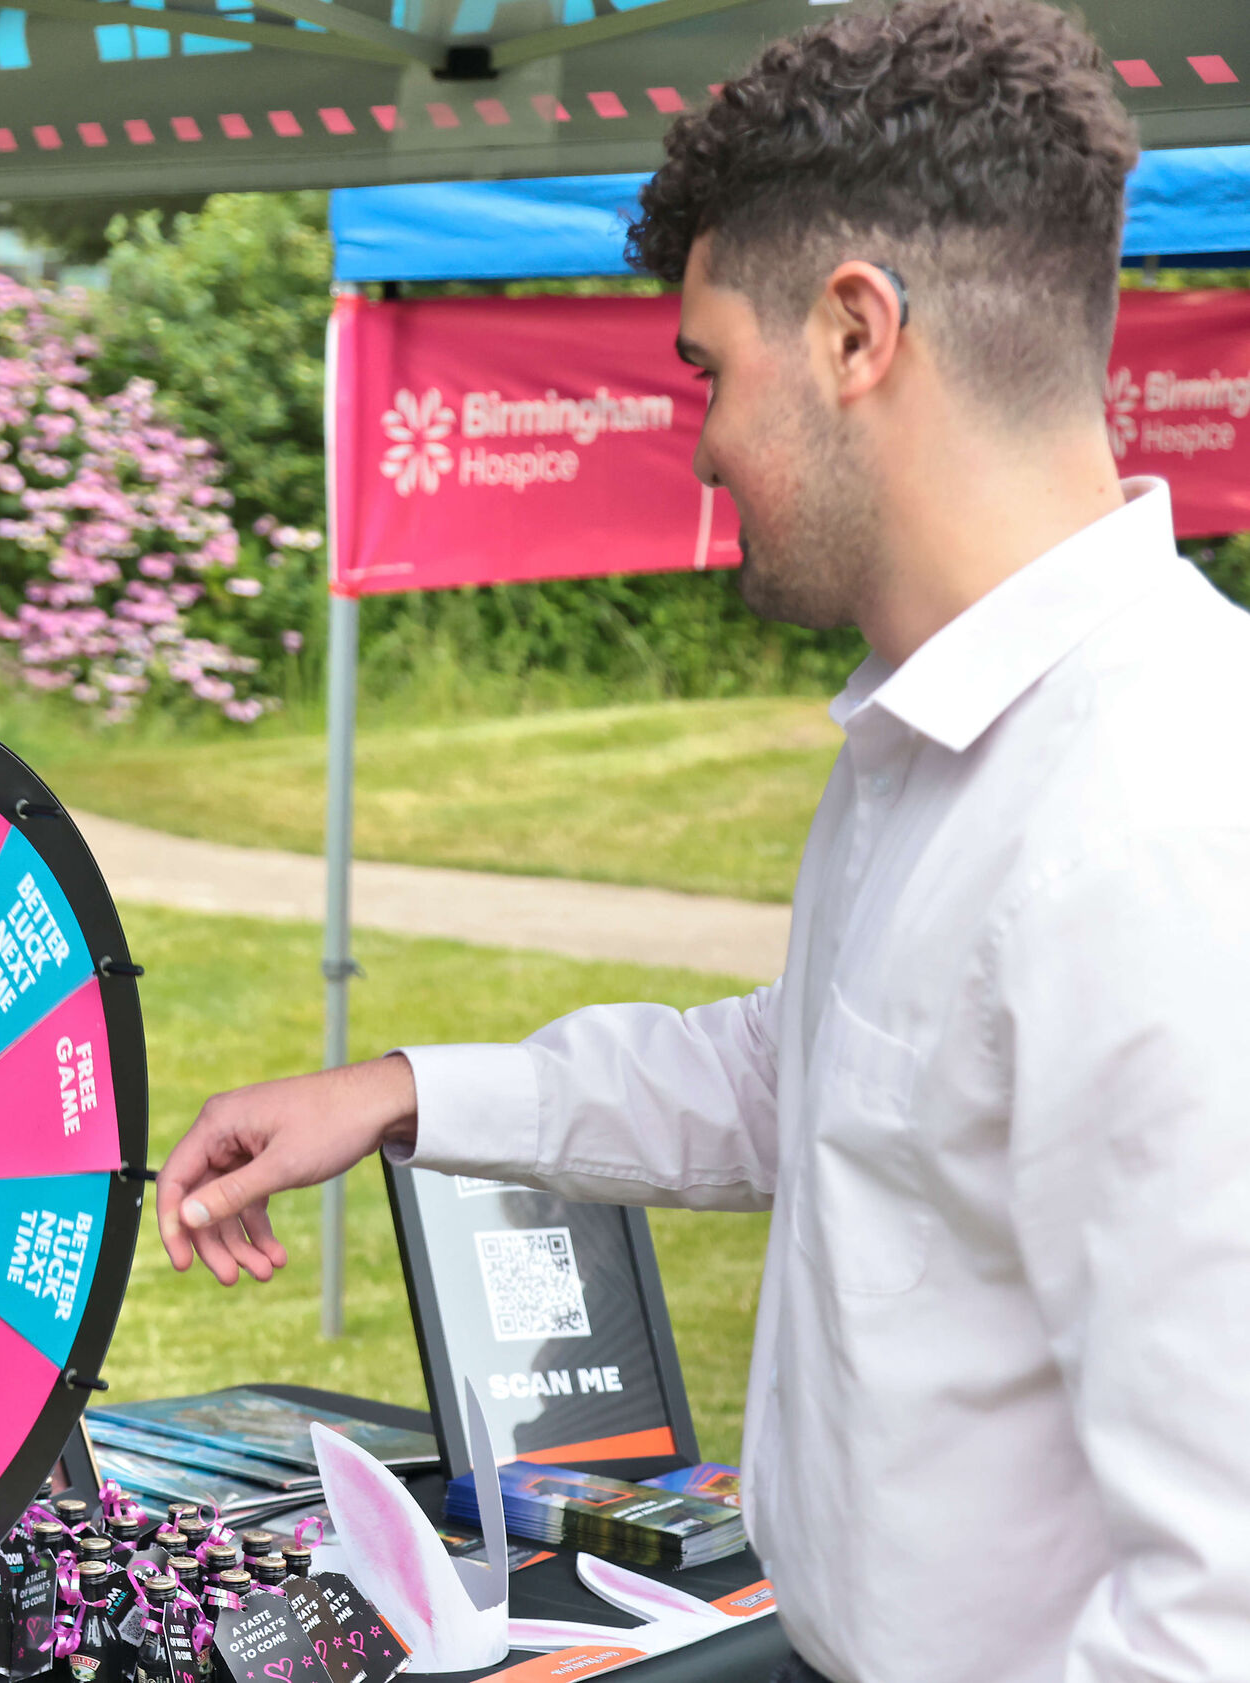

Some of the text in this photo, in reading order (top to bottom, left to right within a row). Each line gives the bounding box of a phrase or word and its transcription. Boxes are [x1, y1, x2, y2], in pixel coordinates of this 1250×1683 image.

[461, 386, 673, 445] Birmingham
[1145, 369, 1250, 418] Birming
[1141, 415, 1236, 460] Hospice
[459, 442, 579, 493] Hospice
[7, 899, 51, 976] LUCK
[17, 871, 70, 968] BETTER
[56, 1036, 81, 1136] GAME
[75, 1041, 98, 1113] FREE
[7, 1210, 38, 1285] TIME
[25, 1209, 57, 1298] NEXT
[42, 1217, 74, 1302] LUCK
[55, 1211, 93, 1321] BETTER
[488, 1366, 623, 1399] SCAN ME
[232, 1609, 272, 1637] A TASTE
[291, 1593, 307, 1611] STE
[301, 1614, 321, 1633] OME
[230, 1616, 286, 1653] OF WHAT'S
[240, 1631, 288, 1662] TO COME
[70, 1655, 99, 1669] AILEYS
